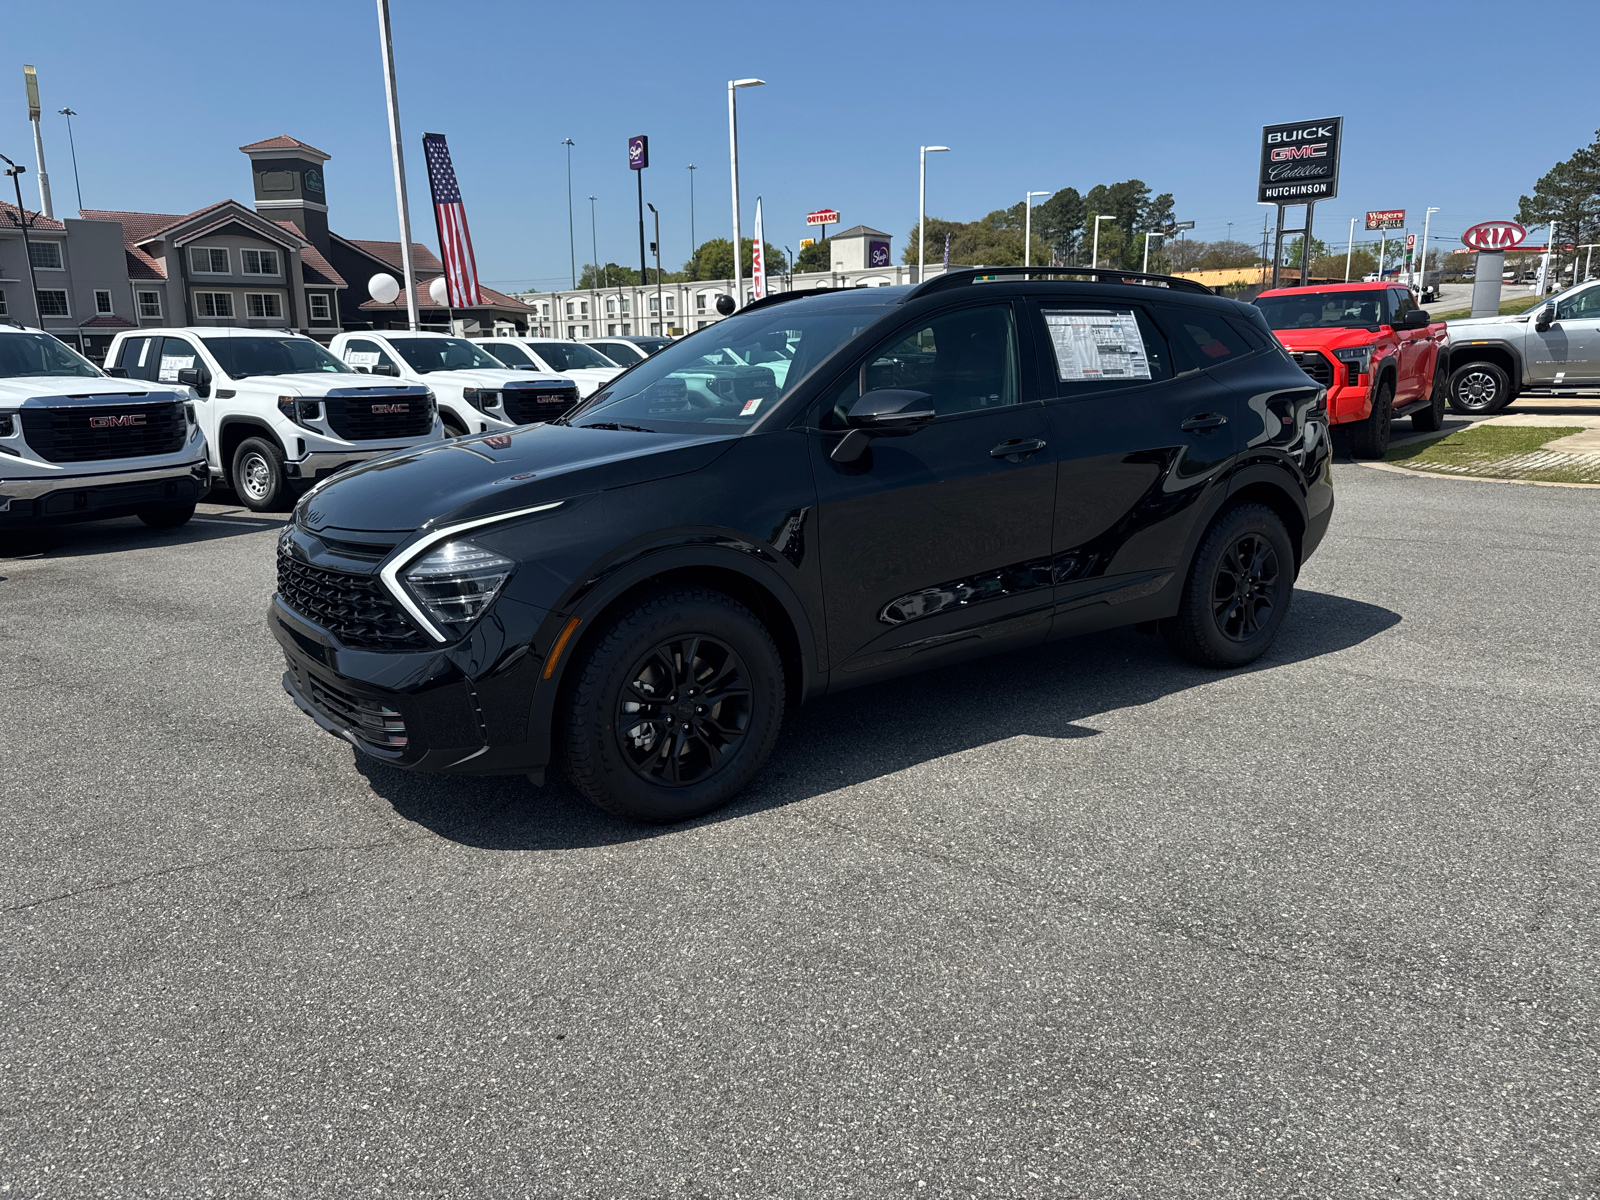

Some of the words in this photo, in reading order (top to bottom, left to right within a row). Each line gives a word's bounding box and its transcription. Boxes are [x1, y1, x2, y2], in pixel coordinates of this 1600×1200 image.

[1268, 126, 1332, 144] BUICK
[1270, 142, 1328, 162] GMC
[1268, 162, 1328, 181] Cadillac
[1266, 184, 1326, 197] HUTCHINSON
[807, 214, 836, 223] OUTBACK
[1368, 212, 1403, 220] Wagers
[1474, 228, 1515, 244] KIA
[537, 395, 564, 403] GMC
[372, 404, 409, 414] GMC
[90, 414, 146, 428] GMC
